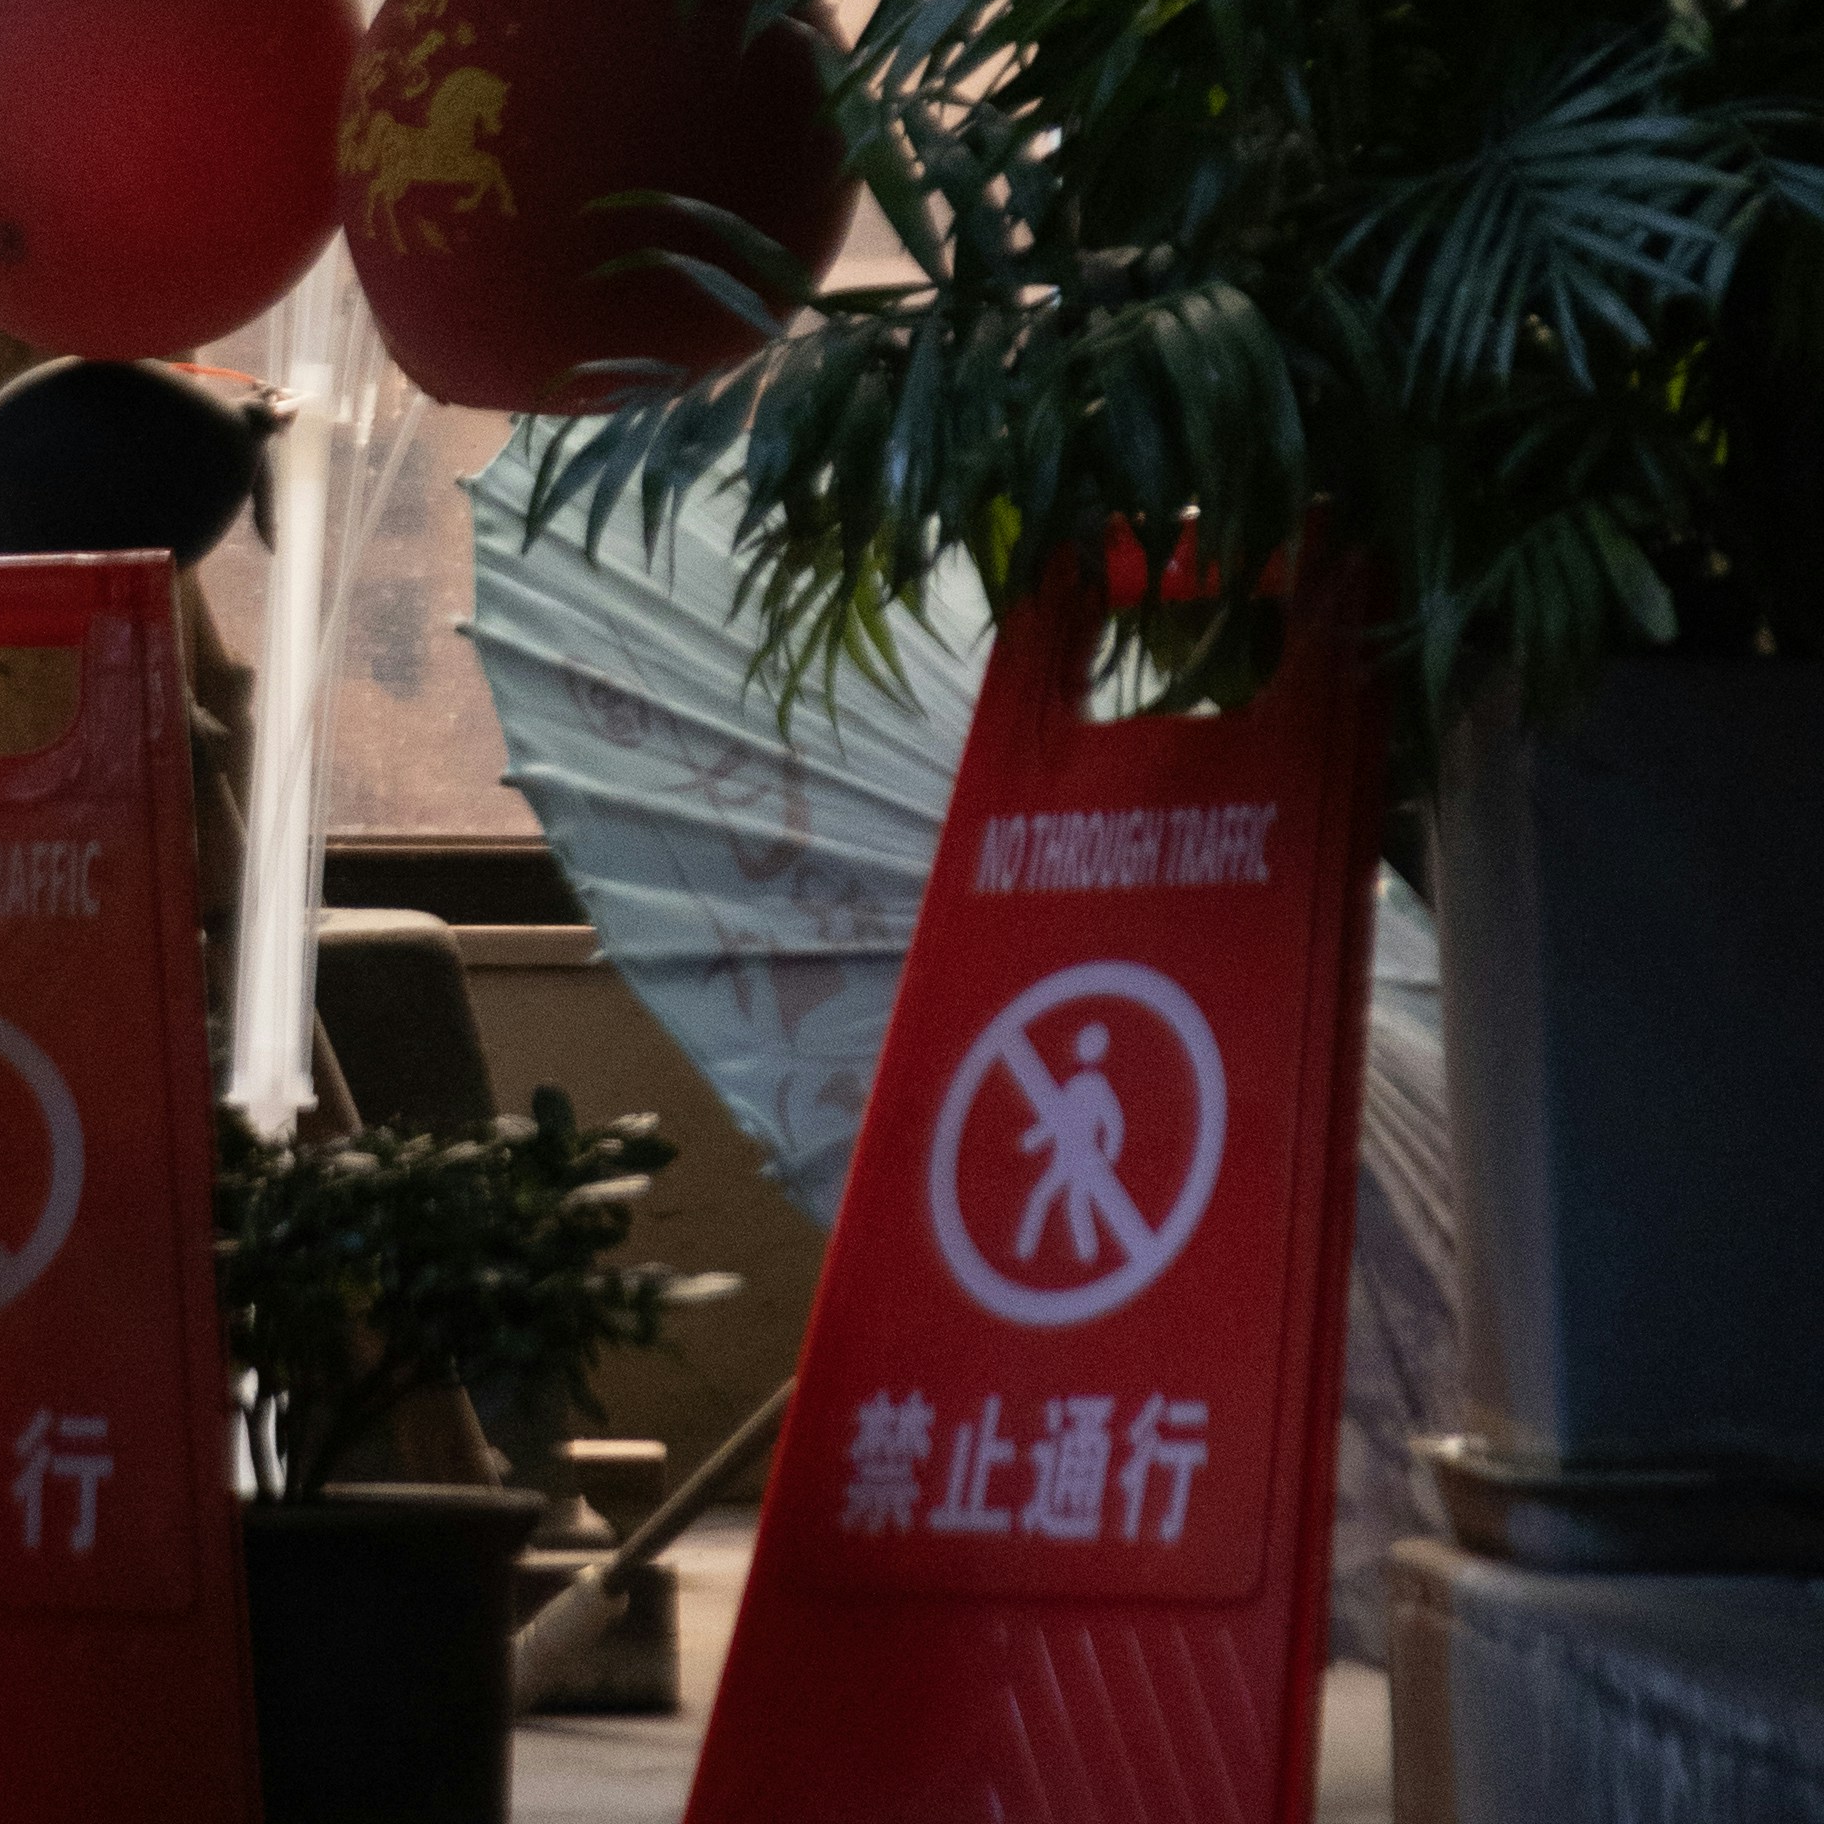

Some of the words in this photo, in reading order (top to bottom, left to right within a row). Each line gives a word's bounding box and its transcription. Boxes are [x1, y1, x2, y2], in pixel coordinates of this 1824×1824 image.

[975, 815, 1025, 892] NO
[1028, 809, 1166, 888] THROUGH
[1167, 803, 1276, 884] TRAFFIC
[839, 1388, 1211, 1542] 禁止通行
